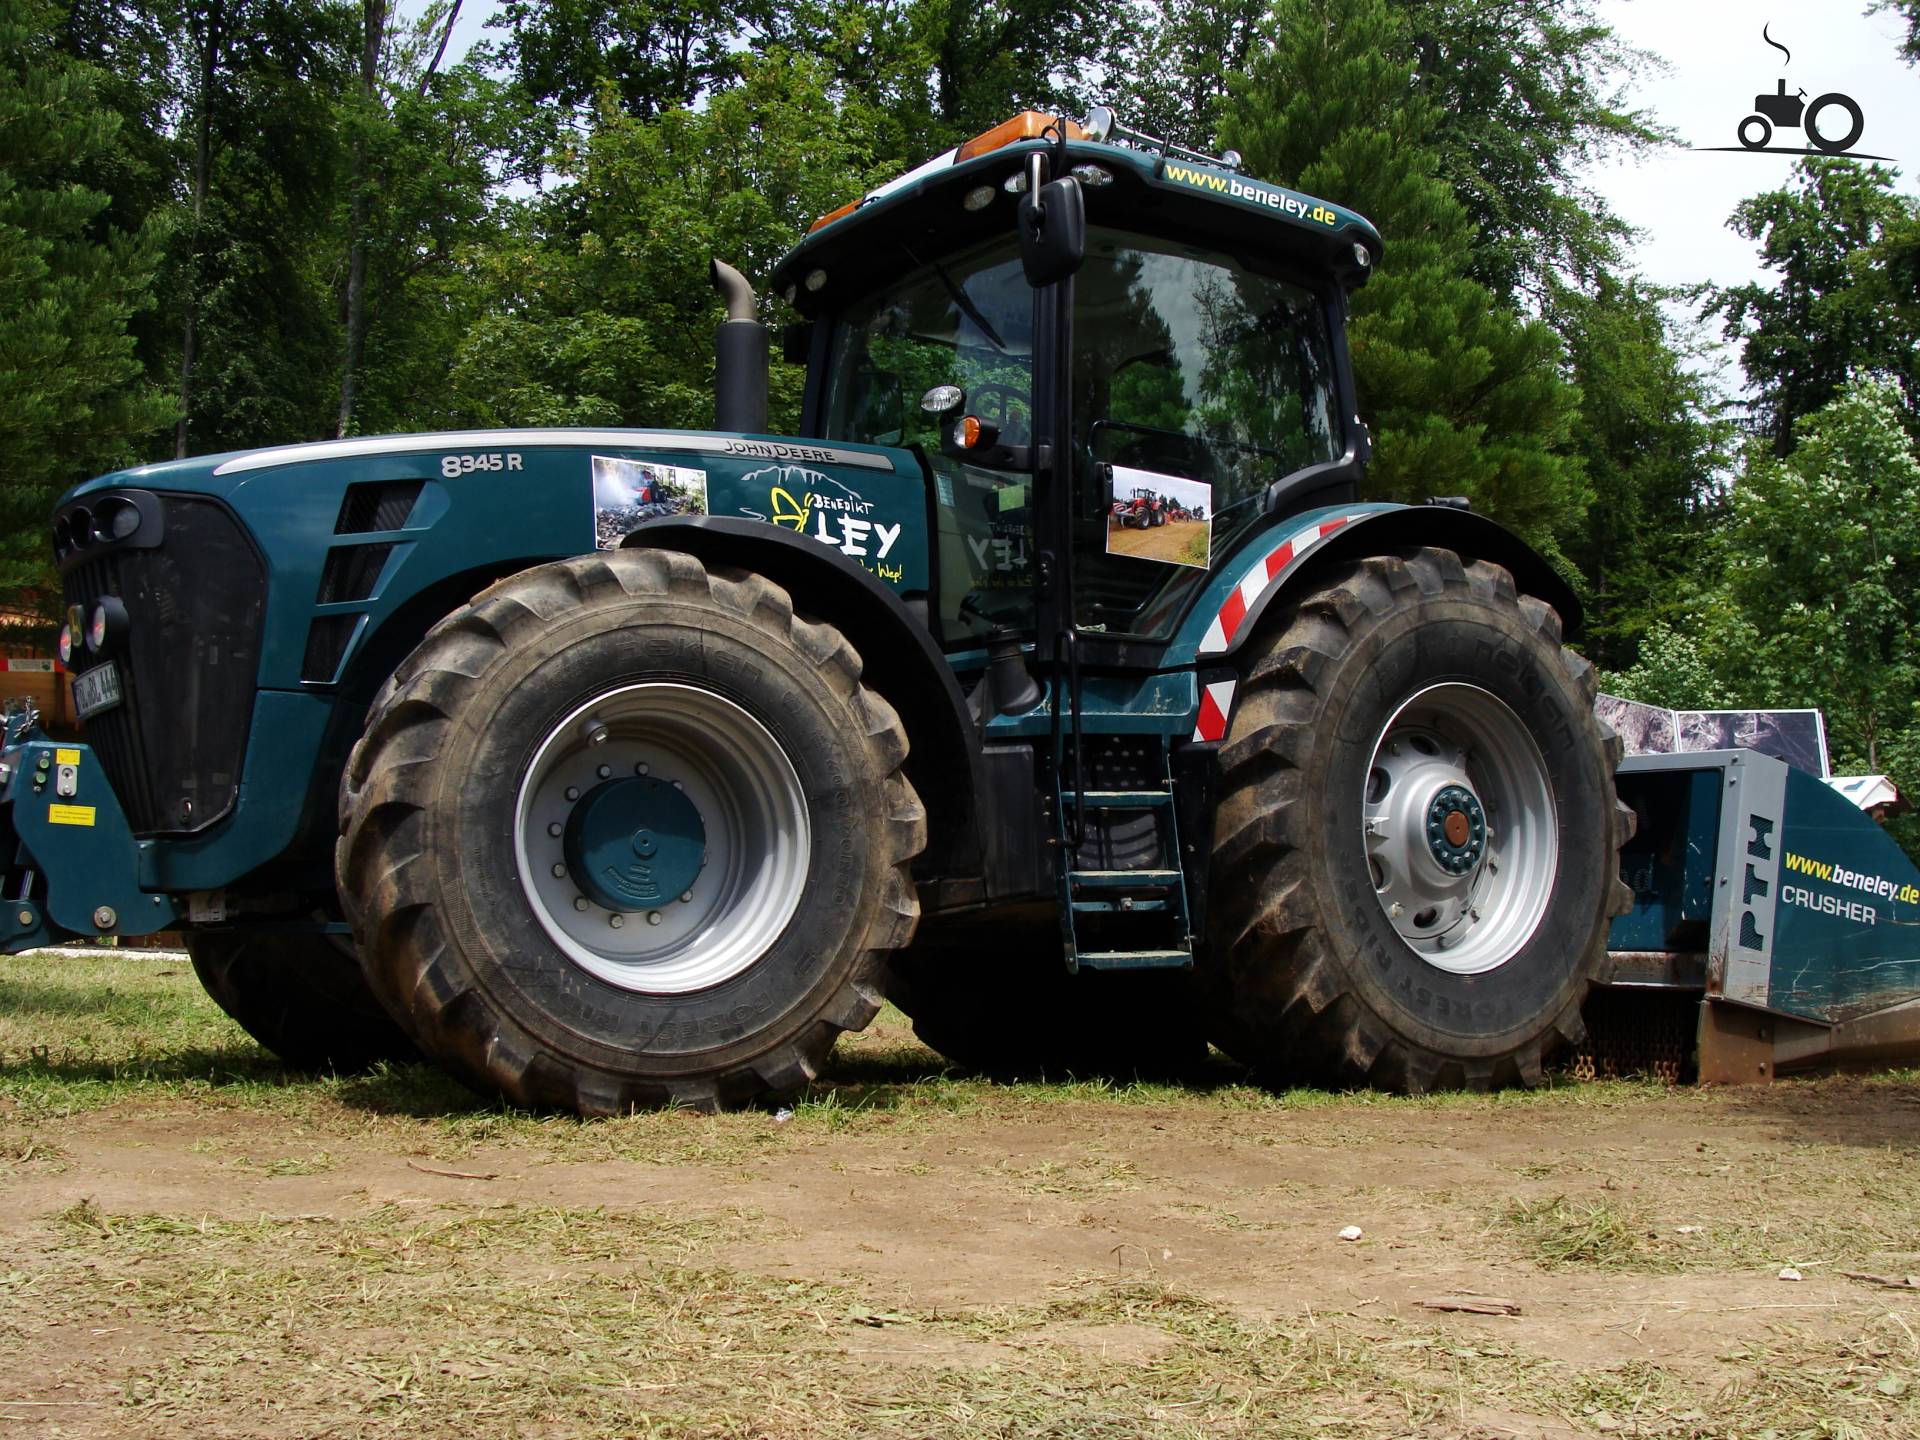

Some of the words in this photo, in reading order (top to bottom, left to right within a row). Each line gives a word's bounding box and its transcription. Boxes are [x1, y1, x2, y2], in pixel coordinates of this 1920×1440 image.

[1166, 164, 1336, 226] www.beneley.de
[441, 453, 504, 478] 8345
[507, 453, 524, 471] R
[724, 440, 772, 456] JOHN
[773, 444, 836, 463] DEERE
[813, 511, 902, 559] LEY
[1785, 851, 1919, 906] www.beneley.de
[1782, 885, 1876, 926] CRUSHER
